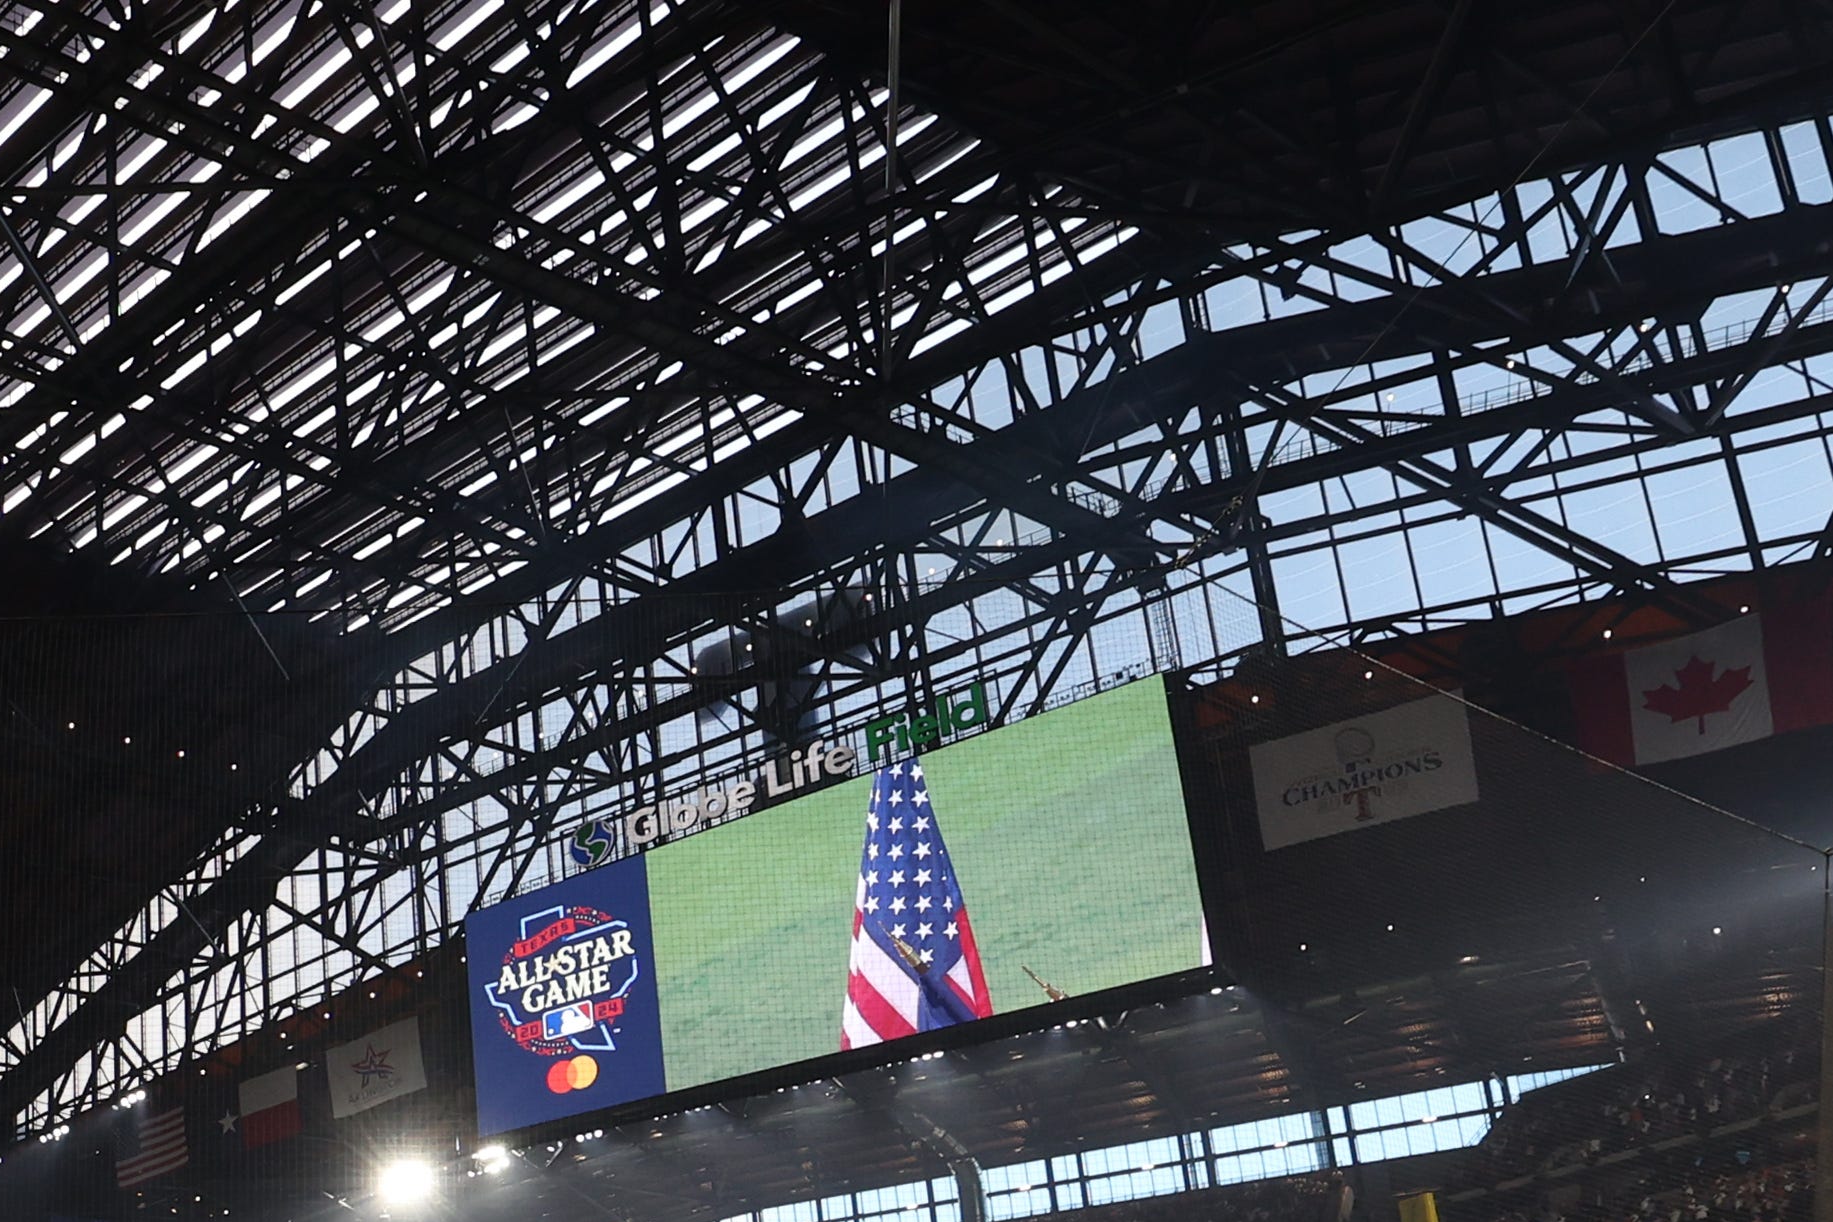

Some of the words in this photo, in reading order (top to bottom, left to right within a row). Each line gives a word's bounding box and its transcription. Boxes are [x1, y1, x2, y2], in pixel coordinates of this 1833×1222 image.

[765, 740, 854, 797] Life
[866, 684, 985, 762] Field
[521, 922, 568, 954] TEXAS
[497, 956, 554, 995] ALL
[556, 930, 635, 975] STAR
[522, 964, 611, 1012] GAME
[598, 1003, 617, 1017] 24
[520, 1024, 539, 1037] 20
